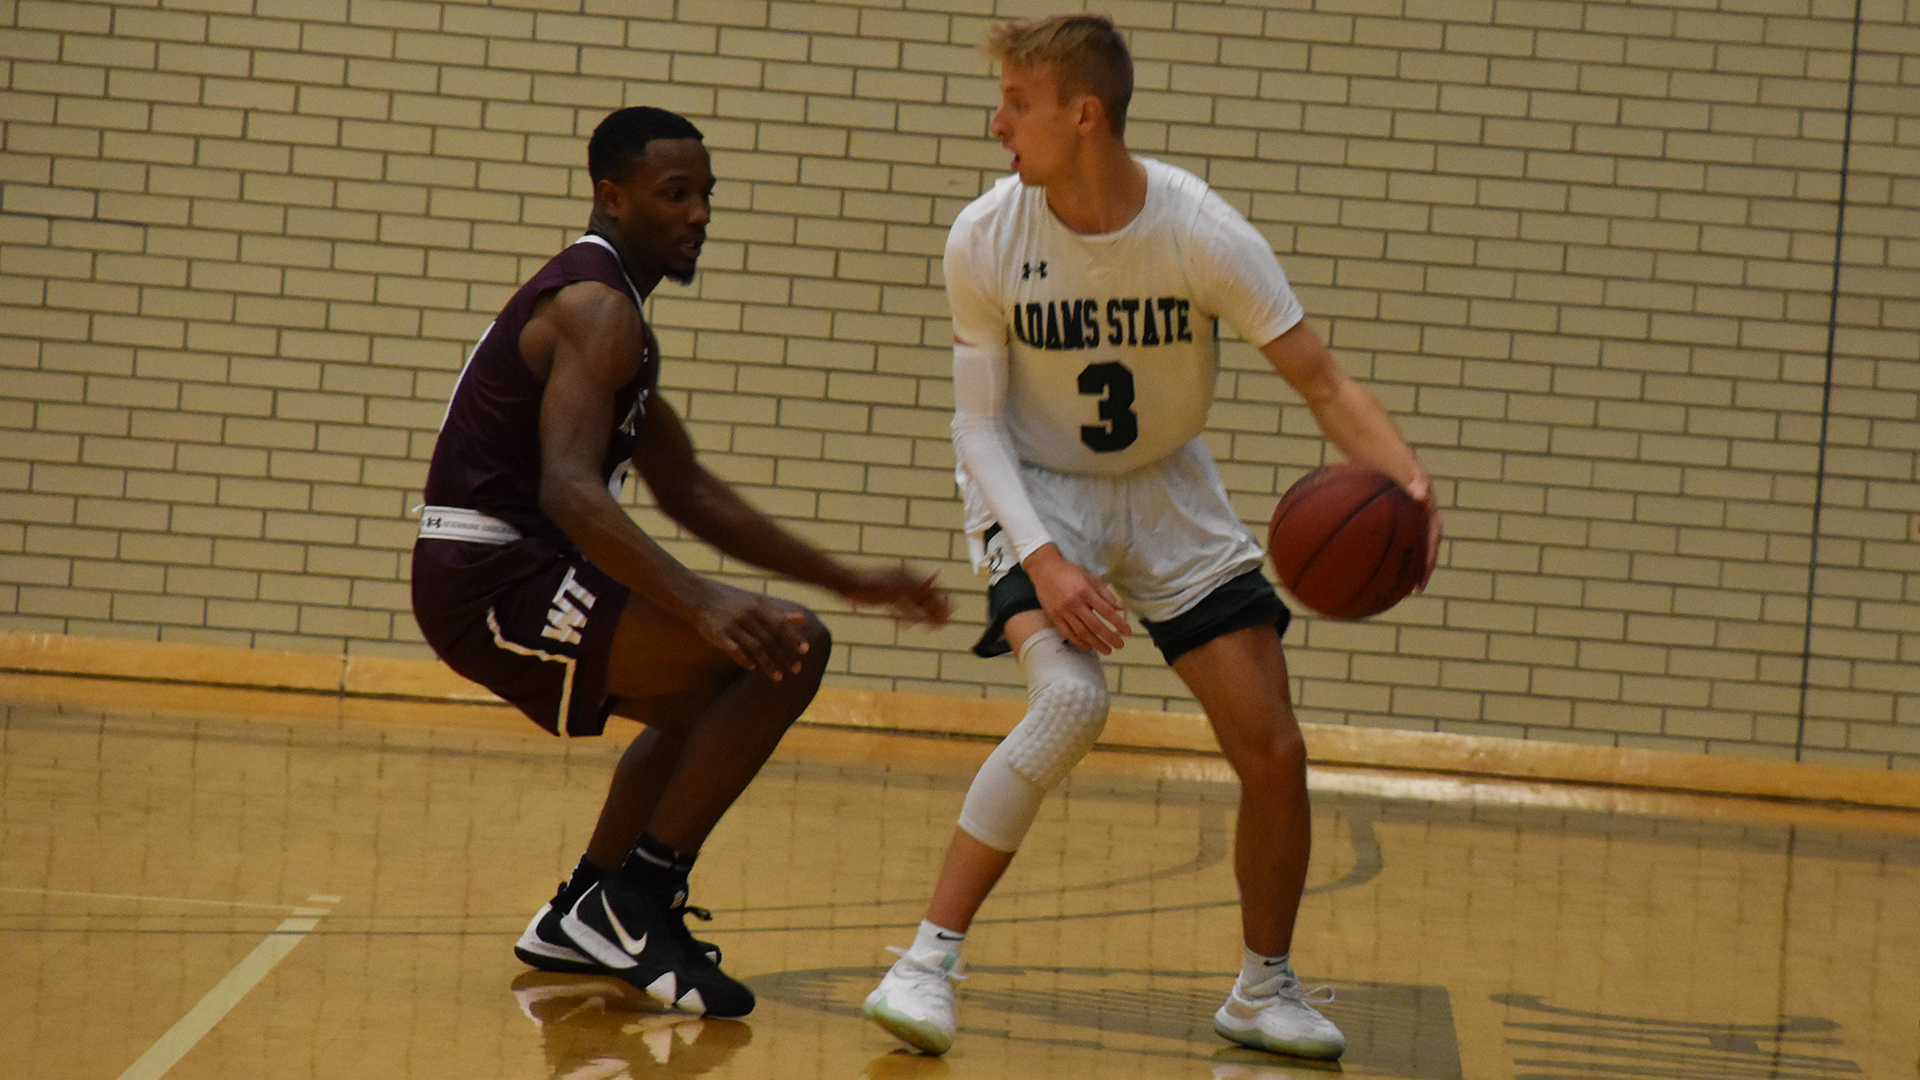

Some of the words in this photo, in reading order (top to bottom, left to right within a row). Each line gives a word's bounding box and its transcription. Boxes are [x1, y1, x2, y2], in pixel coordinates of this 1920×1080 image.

[1106, 297, 1193, 347] STATE
[1077, 360, 1138, 454] 3
[540, 565, 597, 646] WT
